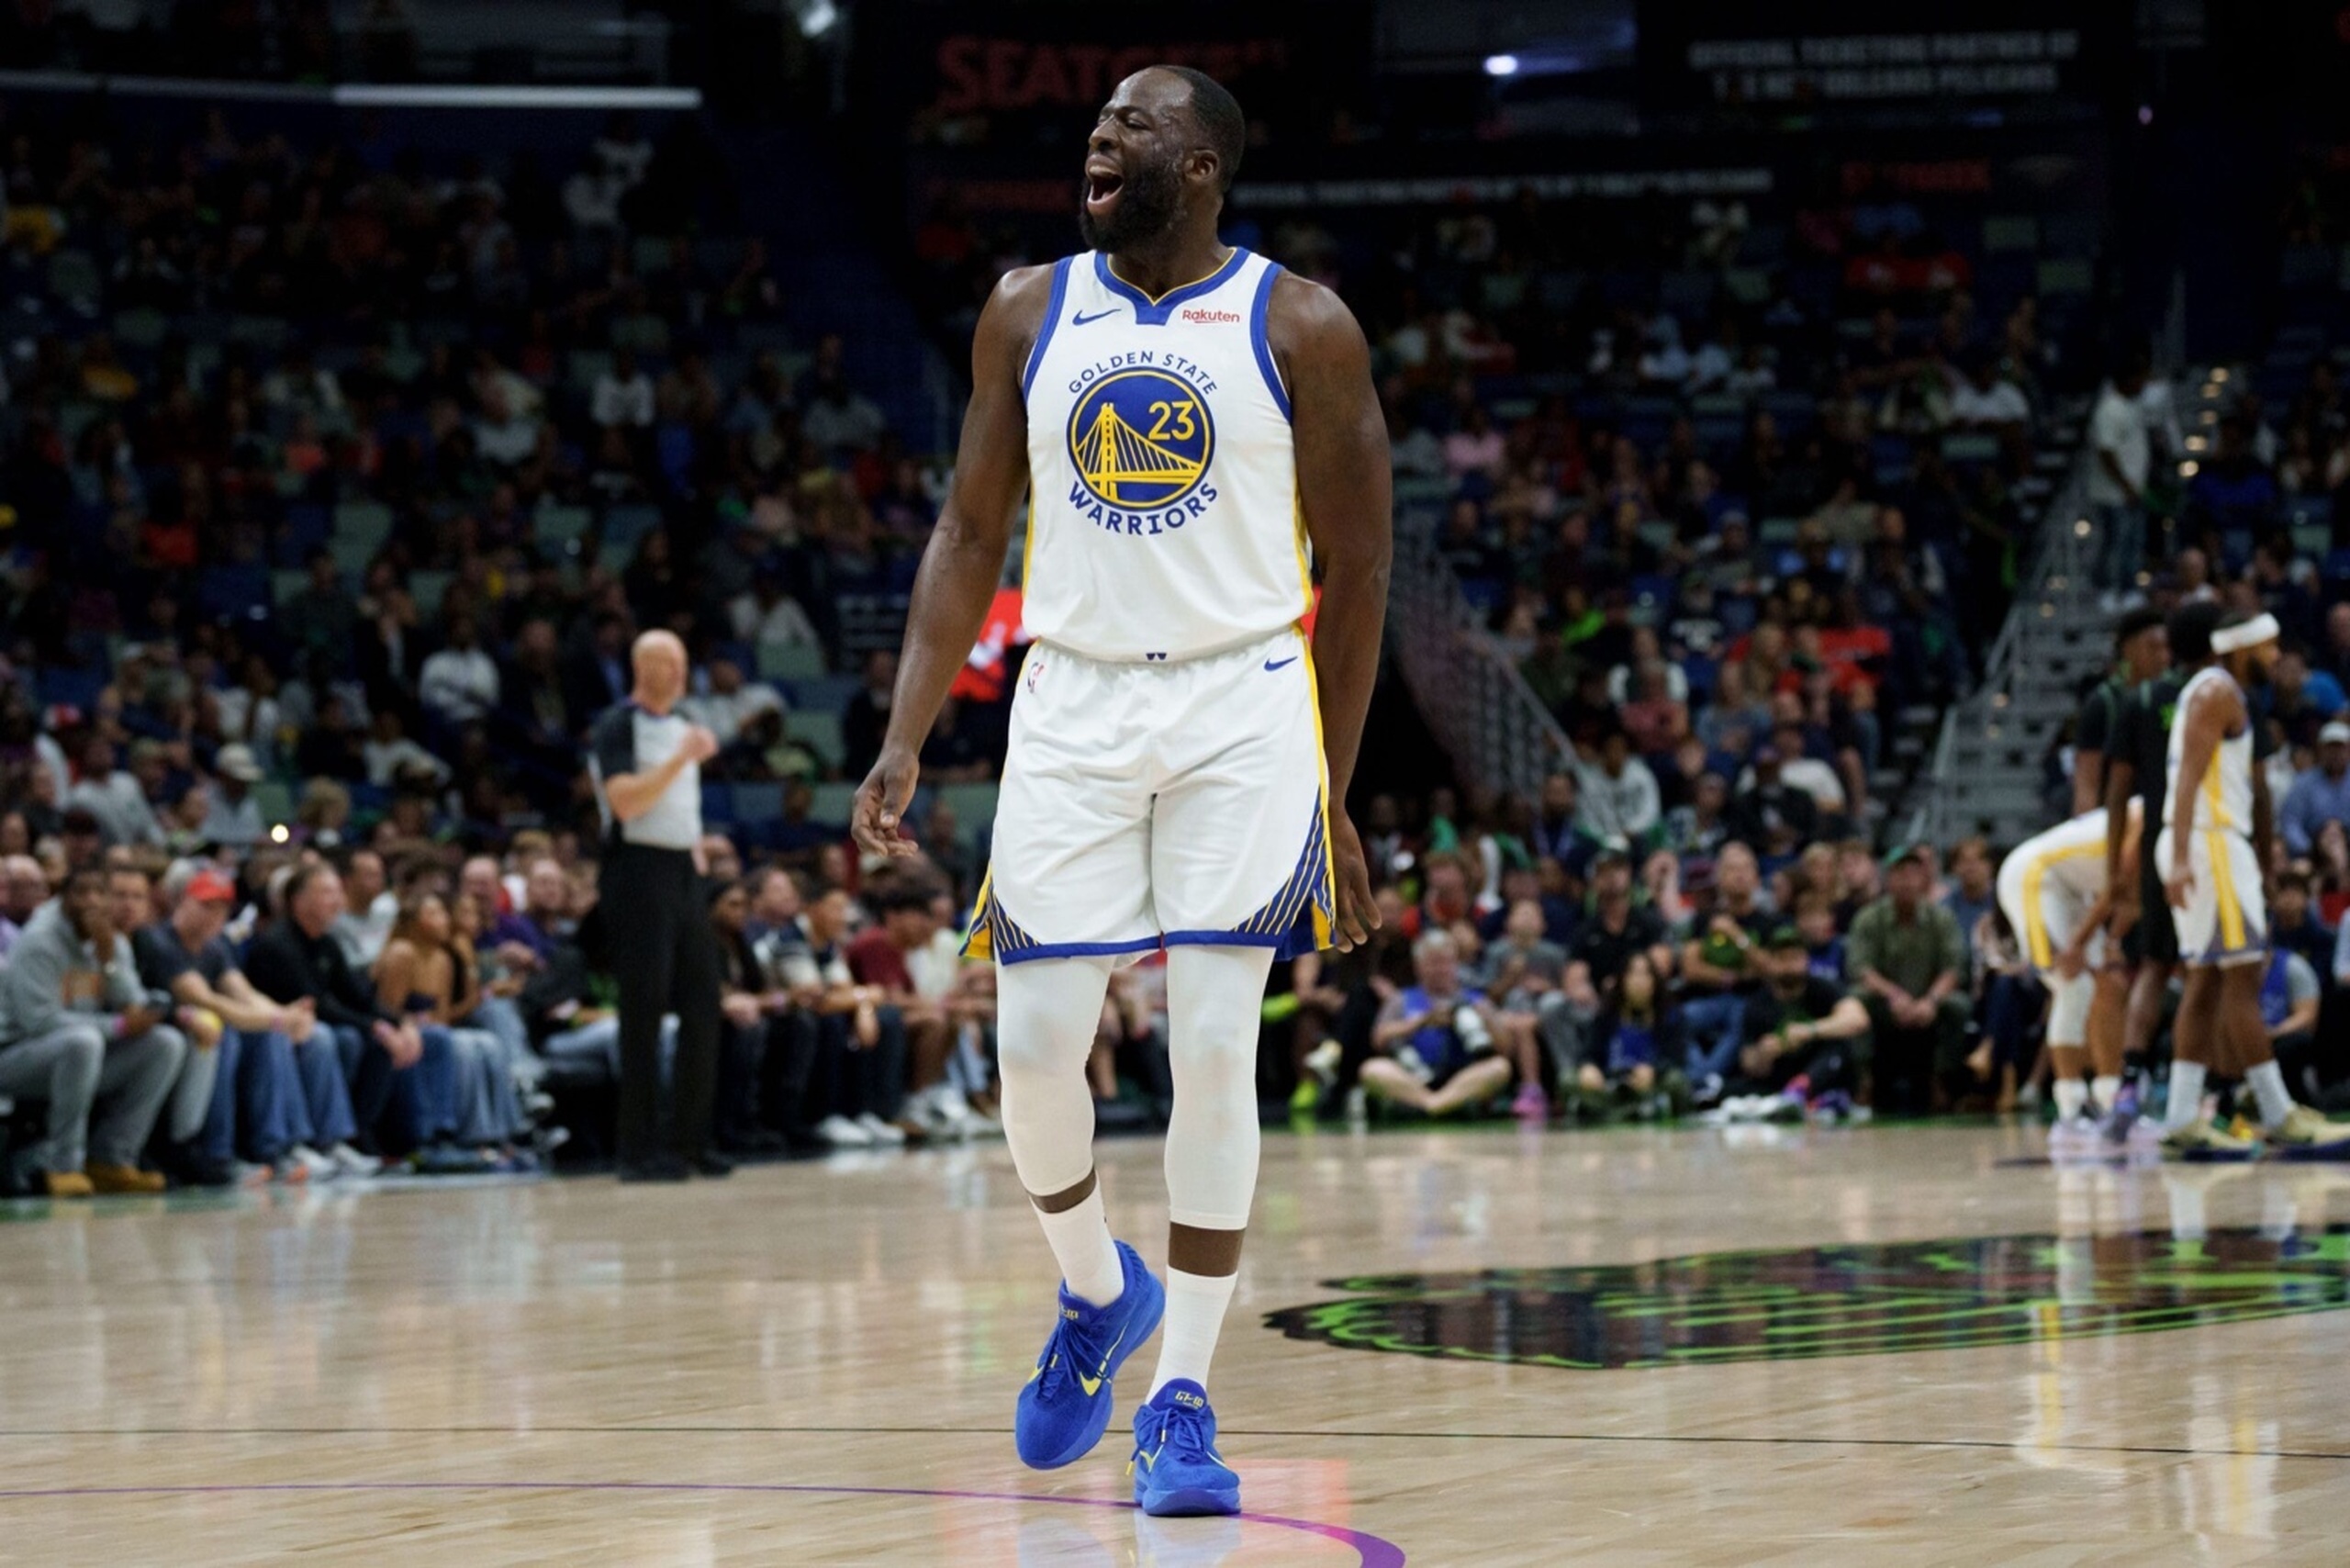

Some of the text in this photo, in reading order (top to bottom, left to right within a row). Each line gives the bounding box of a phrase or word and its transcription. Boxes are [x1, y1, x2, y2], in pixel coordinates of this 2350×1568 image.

[1182, 308, 1240, 323] Rakuten
[1069, 351, 1218, 395] GOLDEN STATE
[1147, 400, 1195, 441] 23
[1069, 481, 1218, 536] WARRIORS
